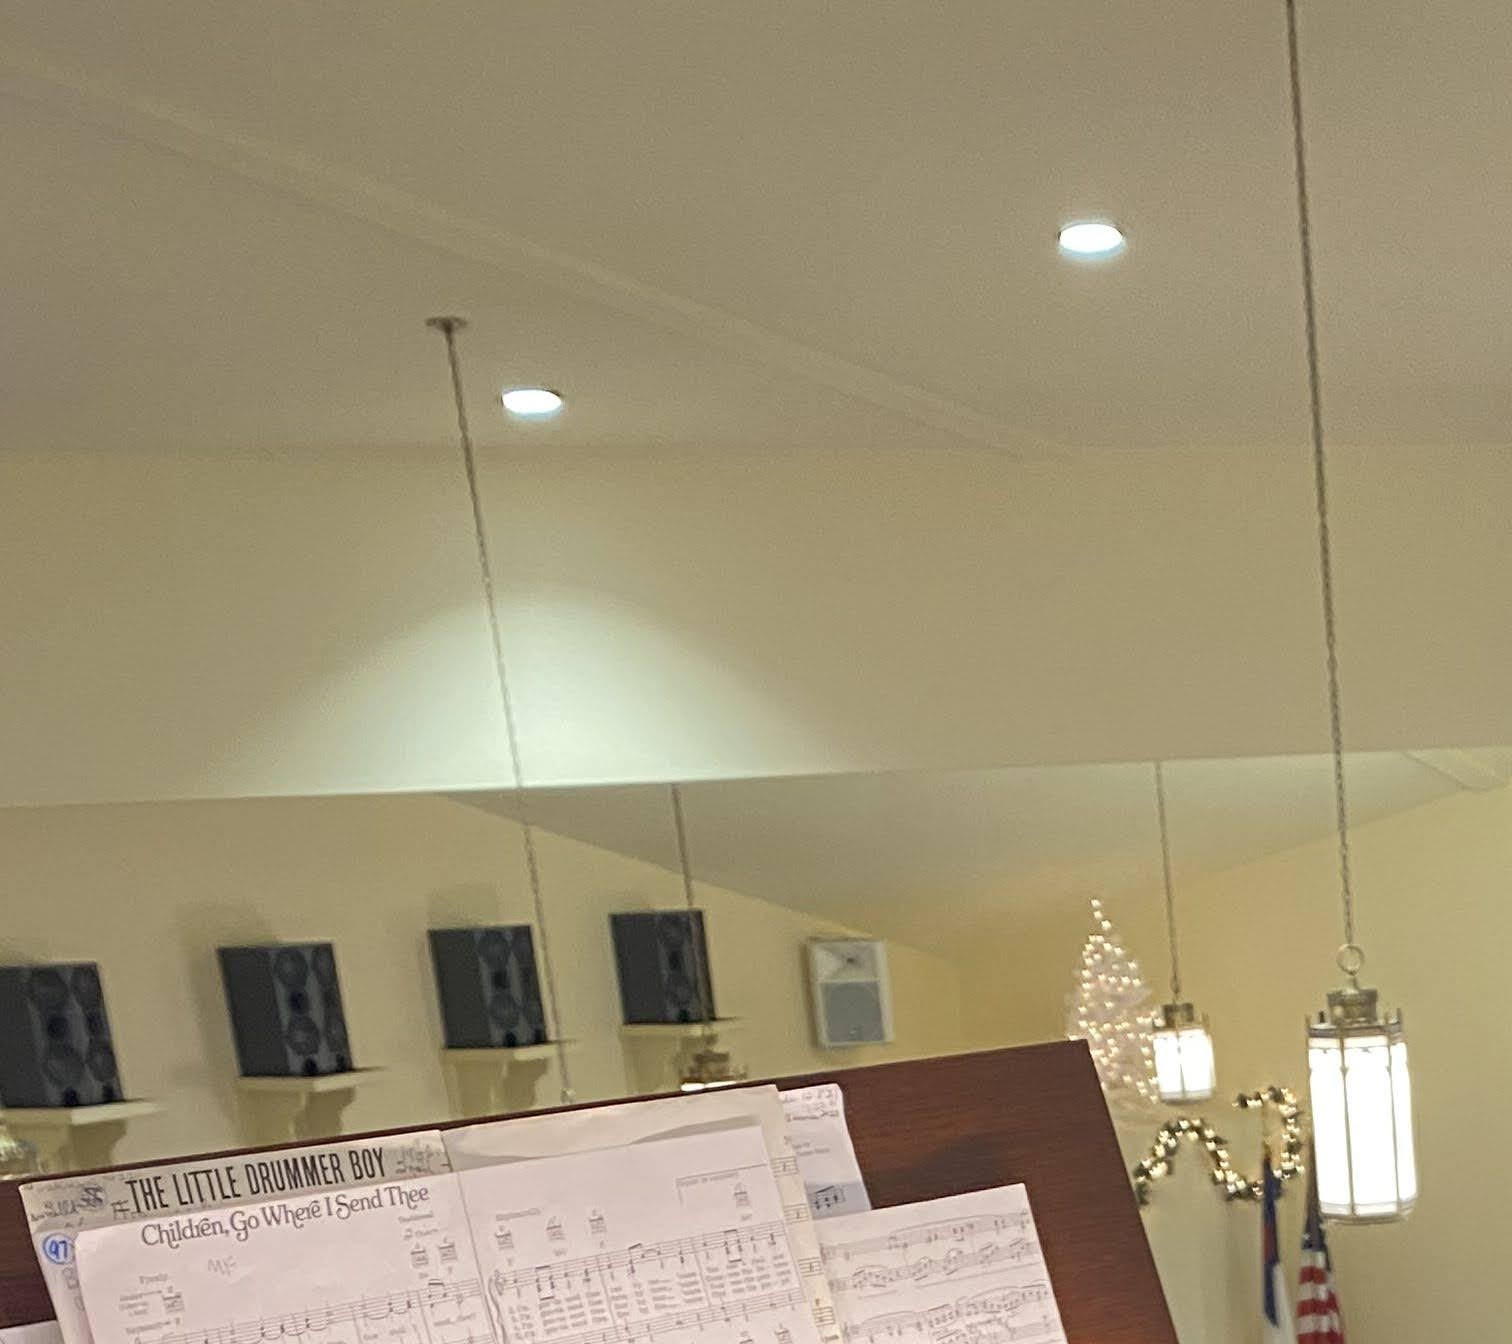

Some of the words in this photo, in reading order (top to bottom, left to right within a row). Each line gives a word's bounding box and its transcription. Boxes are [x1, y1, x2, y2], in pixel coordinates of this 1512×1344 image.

[125, 1176, 169, 1213] THE
[172, 1165, 242, 1206] LITTLE
[246, 1151, 345, 1196] DRUMMER
[349, 1146, 388, 1182] BOY
[141, 1214, 230, 1249] Children,
[230, 1210, 259, 1241] Go
[263, 1199, 322, 1229] Where
[325, 1196, 334, 1217] I
[335, 1189, 383, 1220] Send
[389, 1184, 429, 1212] Thee
